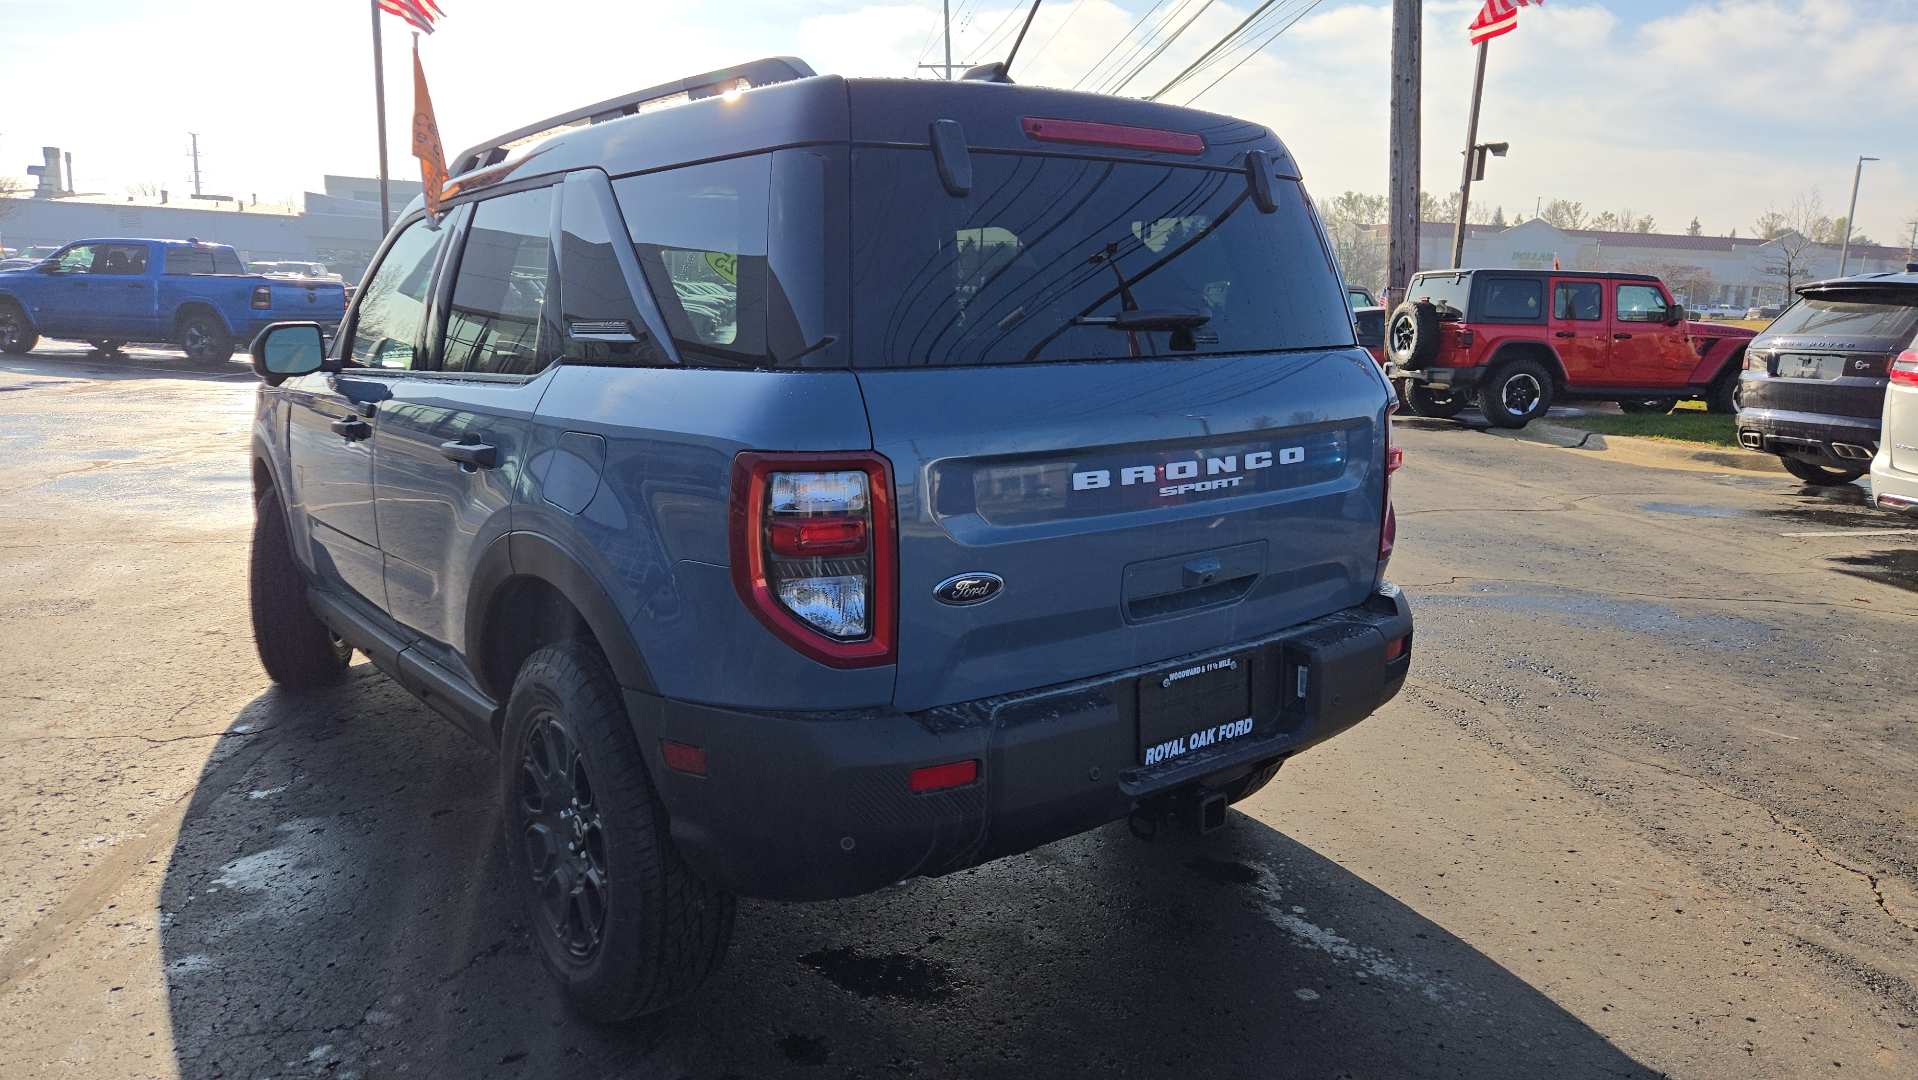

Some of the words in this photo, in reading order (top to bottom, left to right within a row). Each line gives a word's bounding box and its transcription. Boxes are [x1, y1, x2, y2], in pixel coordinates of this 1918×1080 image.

[1512, 251, 1555, 261] DOLLAR
[1809, 341, 1856, 349] ROVER
[1072, 446, 1305, 491] BRONCO
[1158, 476, 1244, 497] SPORT
[951, 579, 990, 599] Ford
[1169, 666, 1201, 681] WOODWARD
[1218, 658, 1232, 669] MILE
[1145, 737, 1186, 766] ROYAL
[1189, 727, 1217, 750] OAK
[1218, 717, 1253, 742] FORD
